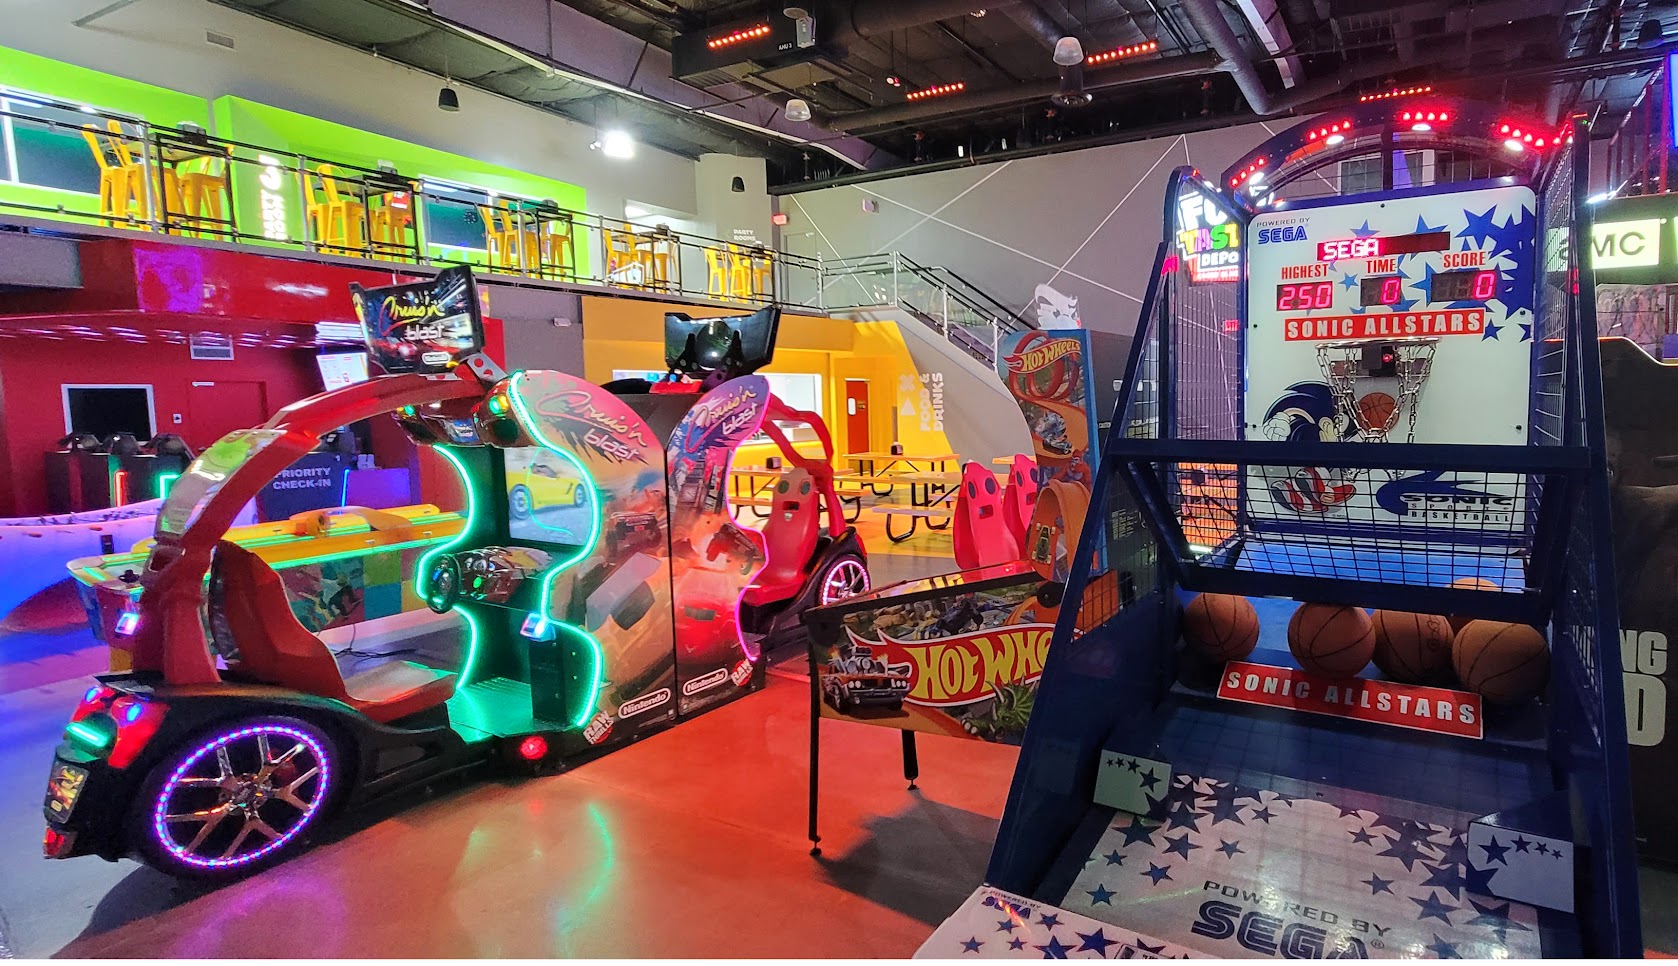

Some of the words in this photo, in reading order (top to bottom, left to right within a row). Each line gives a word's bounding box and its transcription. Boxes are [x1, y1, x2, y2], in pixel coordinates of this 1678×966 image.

[1256, 218, 1296, 227] POWERED
[1258, 225, 1308, 244] SEGA
[1180, 223, 1239, 254] TAST
[1323, 238, 1379, 260] SEGA
[1202, 250, 1239, 267] DEPO
[1366, 258, 1396, 274] TIME
[1443, 251, 1486, 268] SCORE
[1281, 263, 1329, 280] HIGHEST
[1279, 284, 1331, 309] 250
[1382, 279, 1400, 304] 0
[1475, 273, 1495, 299] 0
[404, 322, 445, 340] blast
[1287, 318, 1354, 339] SONIC
[1364, 312, 1480, 335] ALLSTARS
[919, 373, 930, 384] &
[920, 388, 931, 432] FOOD
[932, 372, 944, 432] DRINKS
[722, 402, 758, 436] blast
[584, 428, 640, 460] blast
[272, 478, 332, 490] CHECK-IN
[275, 467, 331, 479] PRIORITY
[1411, 511, 1510, 522] BASKETBALL
[969, 630, 1055, 693] WHE
[1619, 628, 1668, 676] NG
[687, 672, 724, 692] Nintendo
[623, 692, 667, 714] Nintendo
[1226, 671, 1311, 699] SONIC
[1324, 685, 1475, 724] ALLSTARS
[583, 710, 610, 742] RAW
[1203, 880, 1339, 925] POWRED
[1351, 918, 1392, 937] BY
[1190, 900, 1369, 959] SEGA
